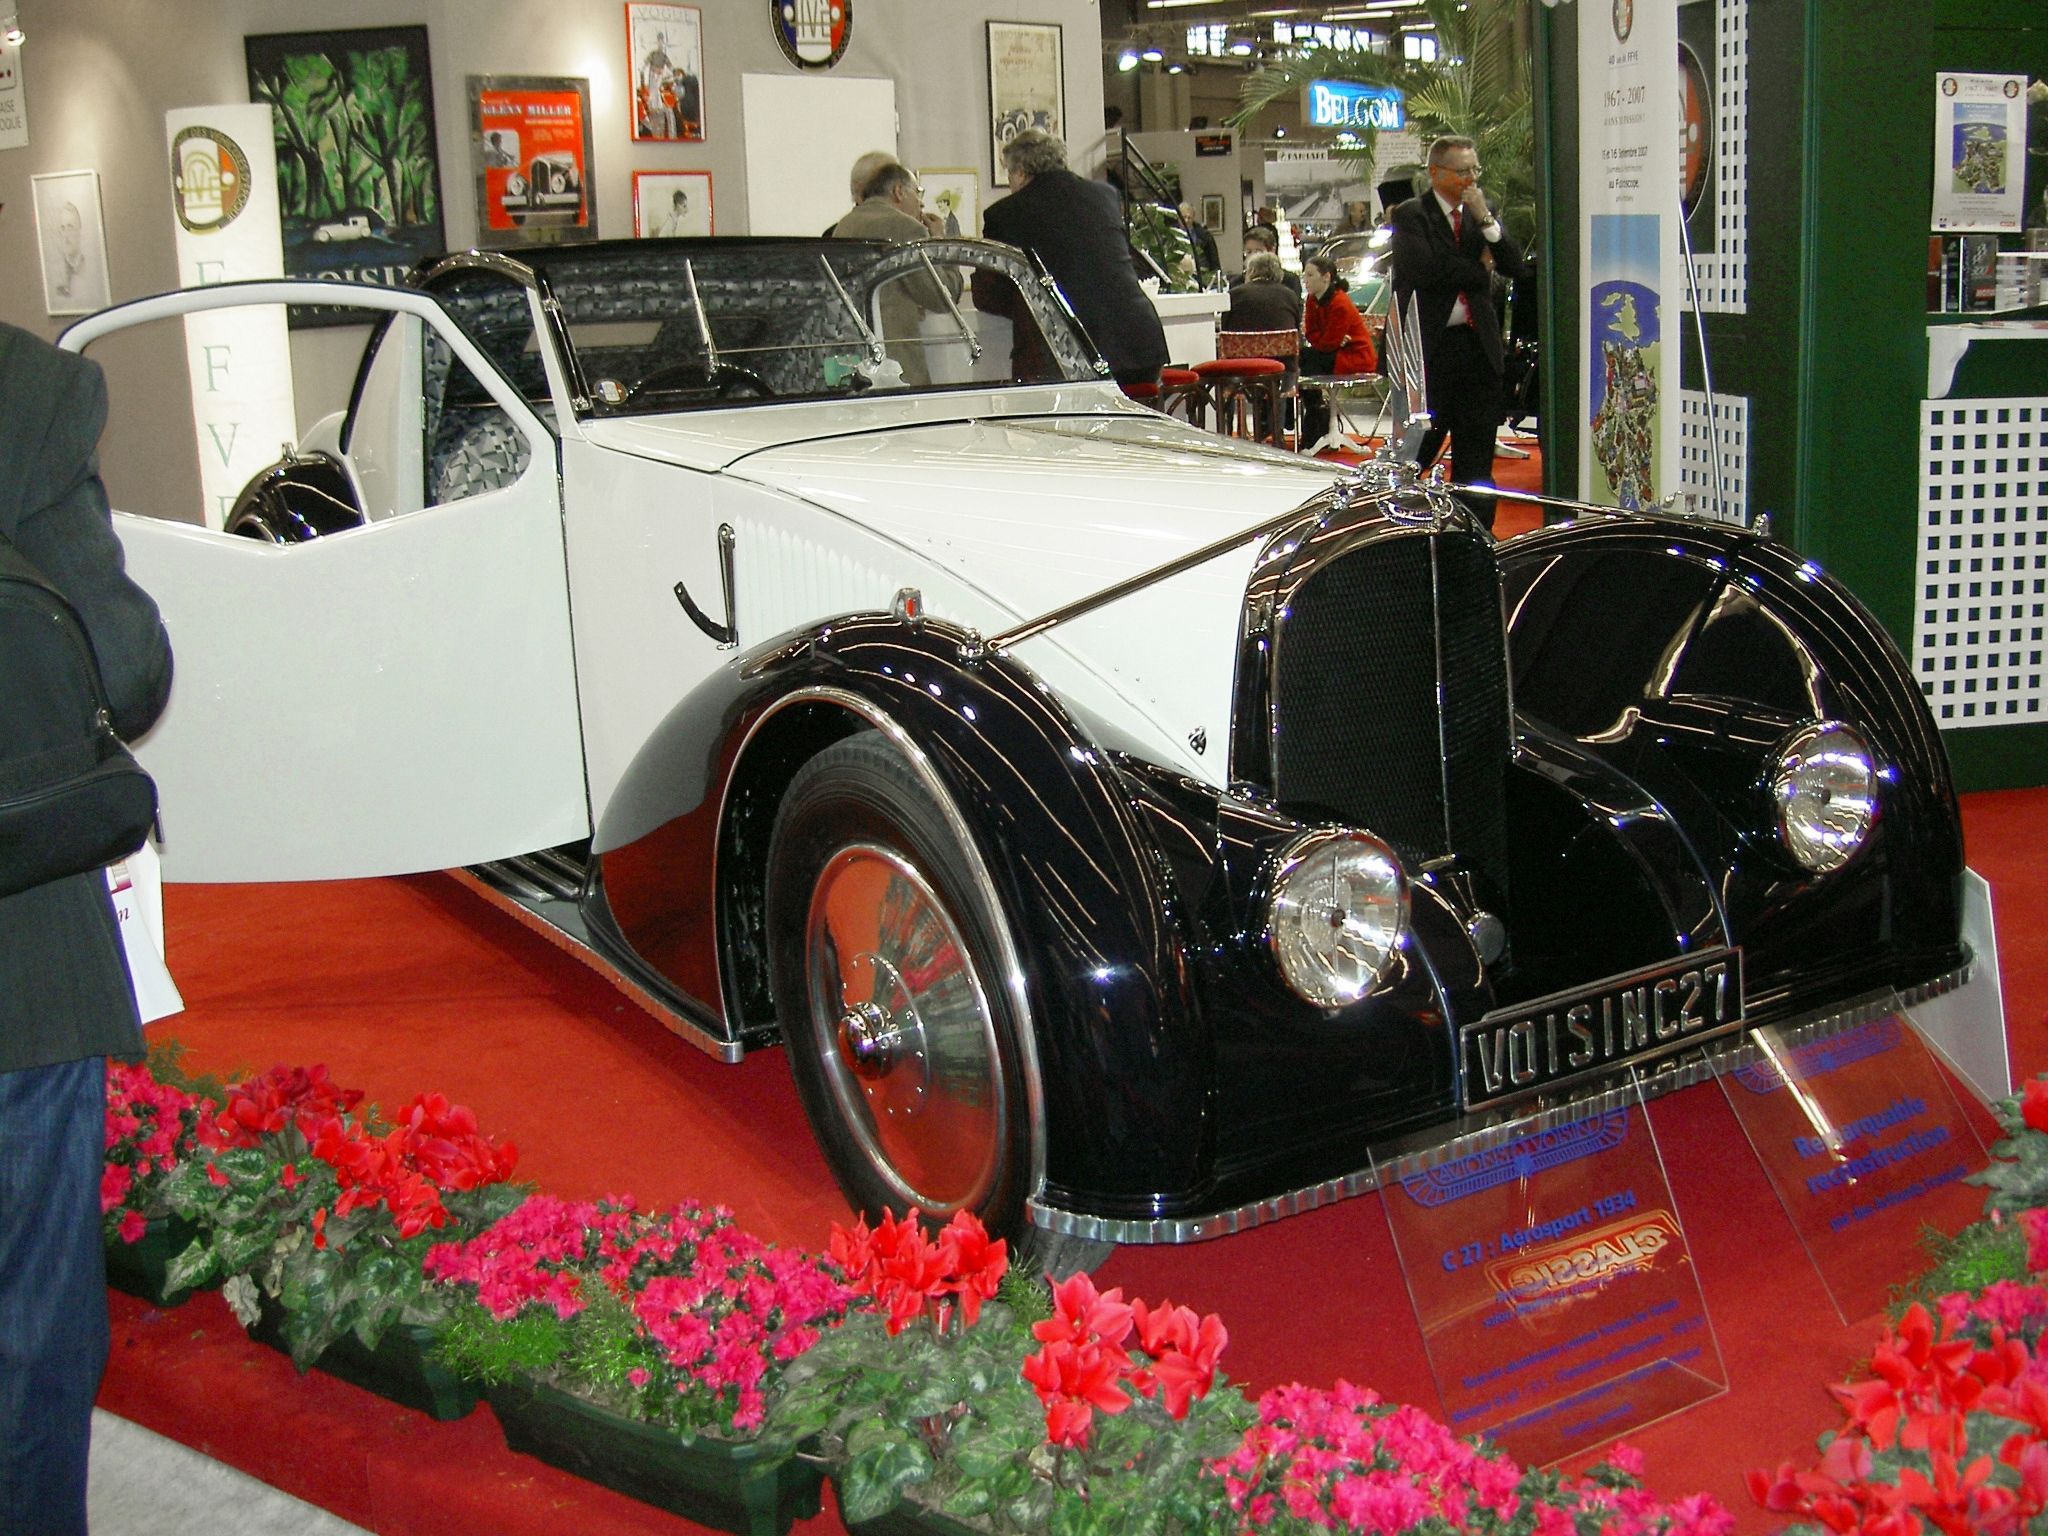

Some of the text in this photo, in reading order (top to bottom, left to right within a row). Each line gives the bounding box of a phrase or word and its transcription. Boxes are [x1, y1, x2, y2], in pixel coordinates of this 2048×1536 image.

[1603, 89, 1620, 108] 1967
[1628, 86, 1646, 104] 2007
[526, 104, 571, 116] MILLER
[1441, 1251, 1457, 1273] C
[1460, 1242, 1484, 1267] 27
[1499, 1206, 1592, 1253] Aérosport
[1593, 1189, 1637, 1218] 1934
